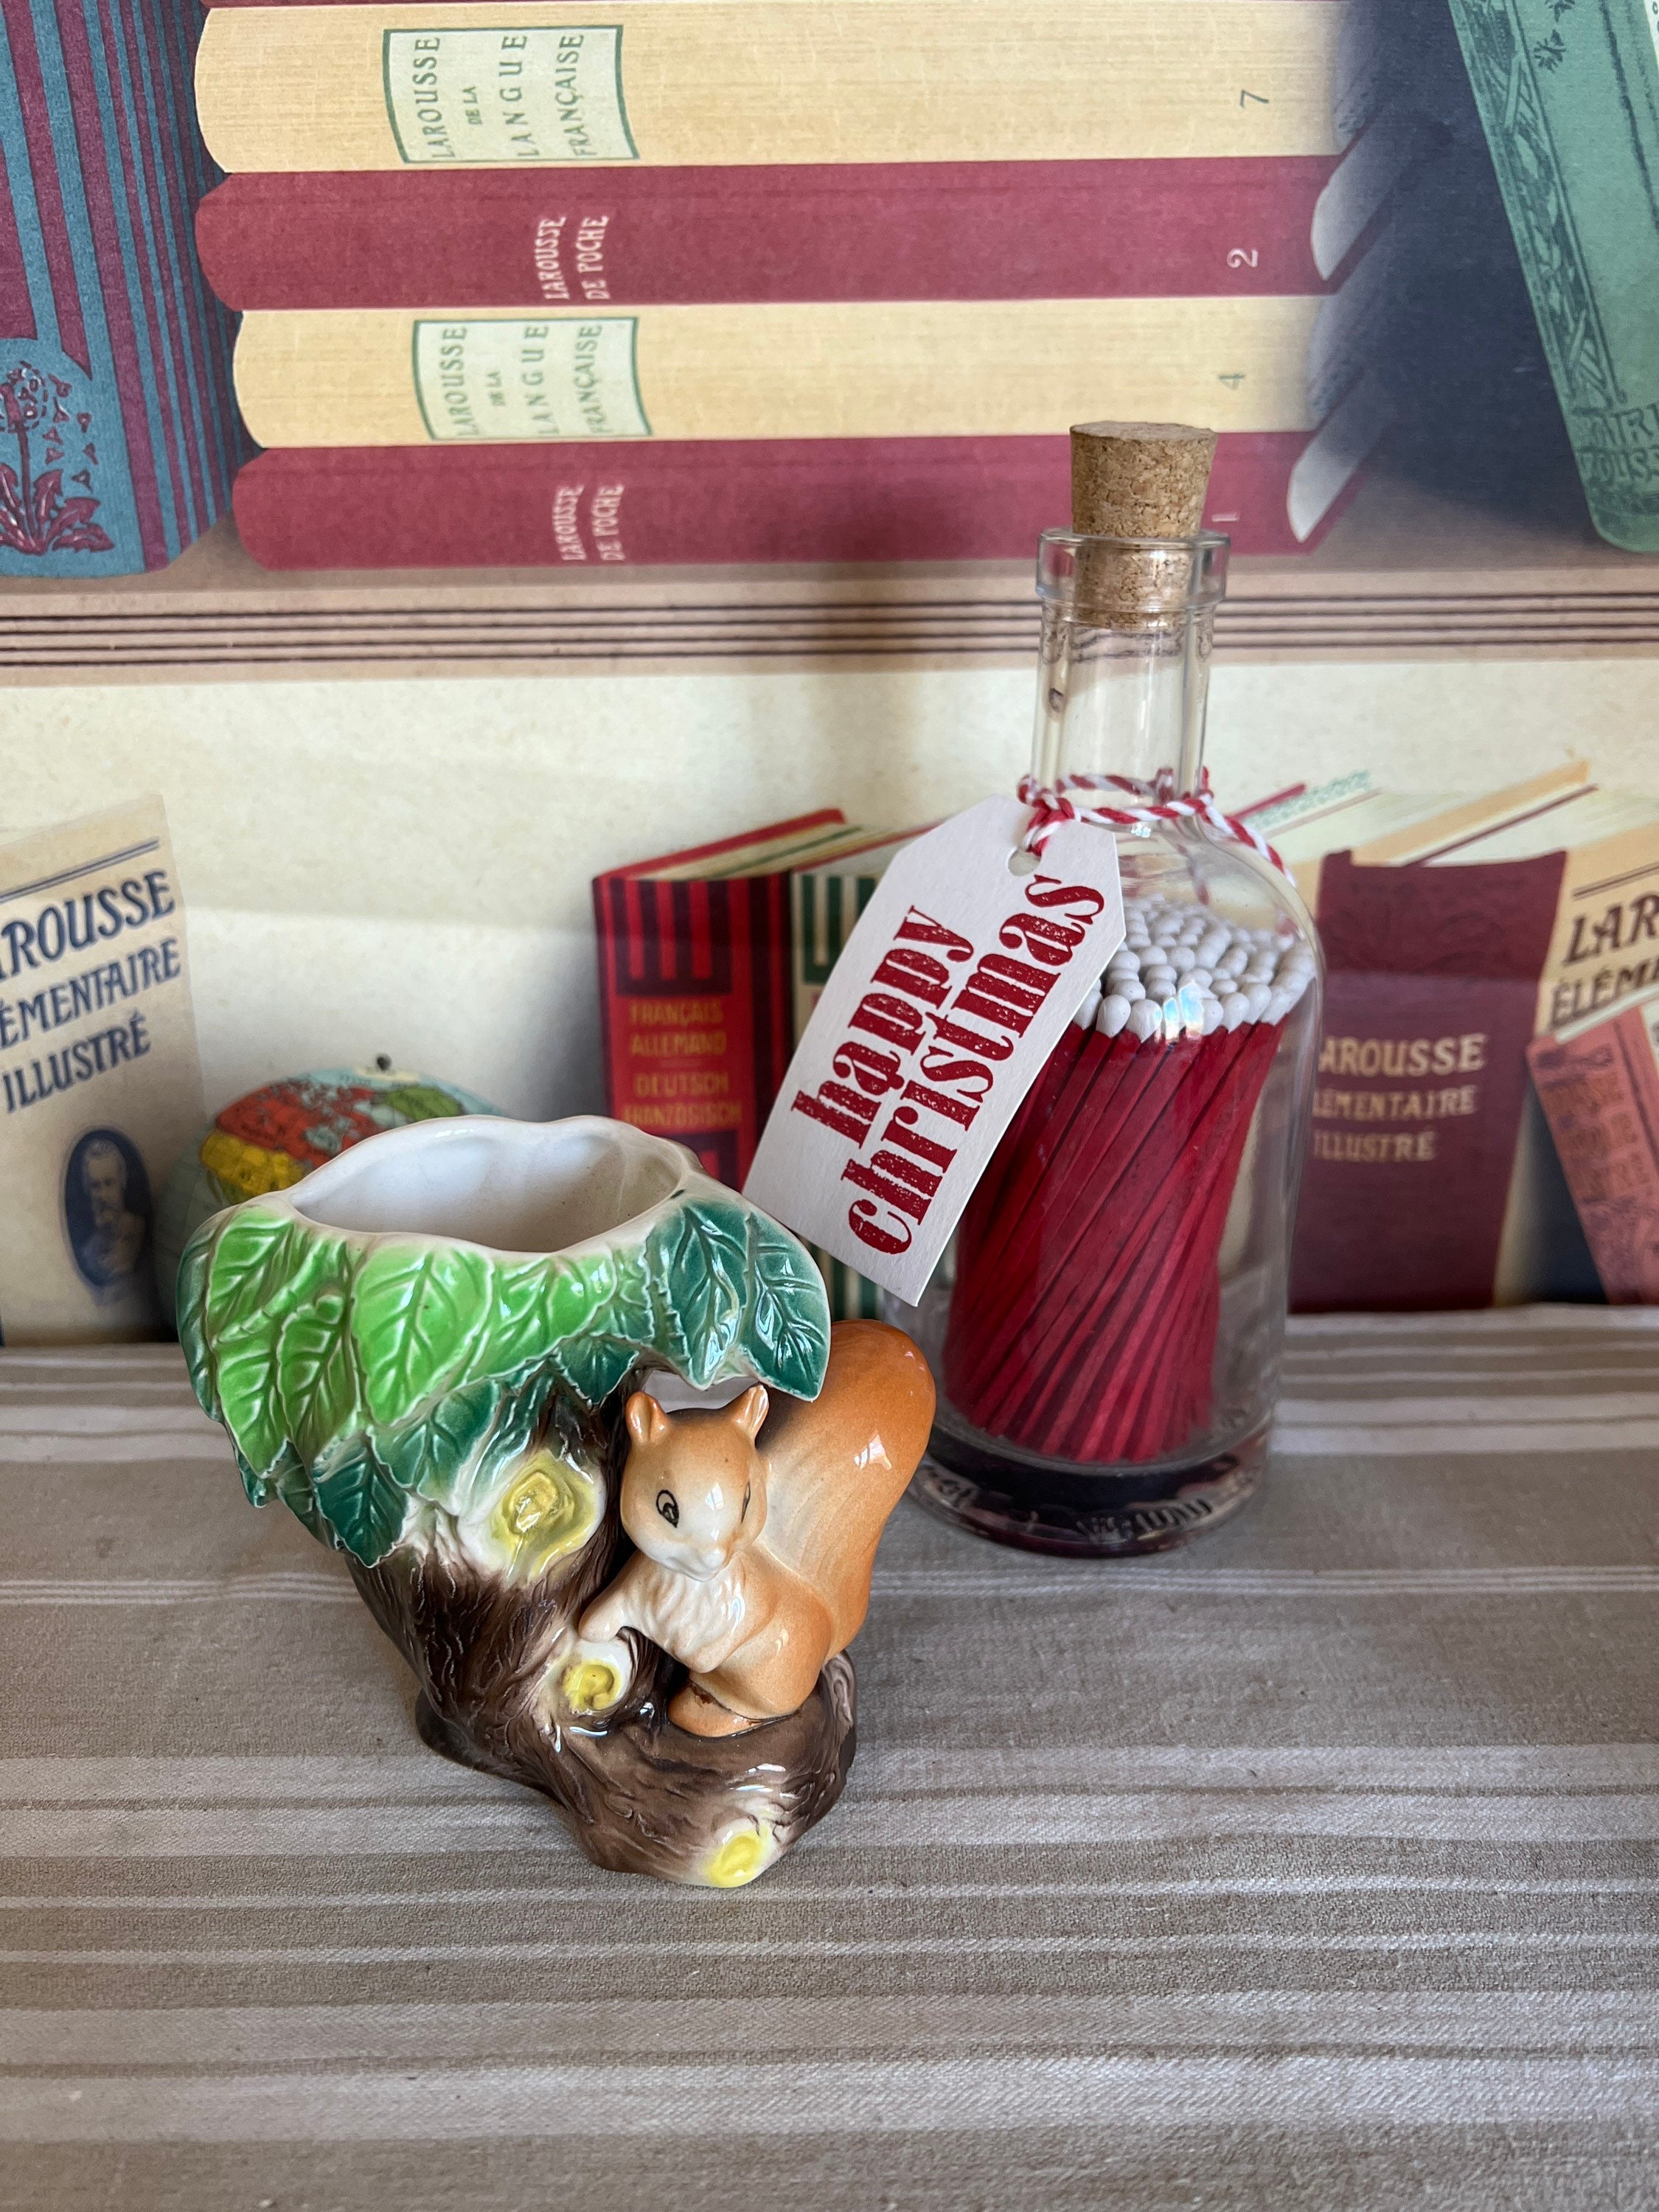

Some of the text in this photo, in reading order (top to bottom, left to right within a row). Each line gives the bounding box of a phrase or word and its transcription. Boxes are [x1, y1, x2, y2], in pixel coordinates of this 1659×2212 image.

[412, 37, 456, 159] LAROUSSE
[462, 86, 483, 125] DE LA
[498, 35, 540, 157] LANGUE
[554, 34, 597, 157] FRANÇAISE
[1239, 88, 1270, 108] 7
[534, 215, 570, 300] LAROUSSE
[575, 215, 611, 300] DE POCHE
[1226, 248, 1259, 268] 2
[440, 325, 480, 437] LAROUSSE
[484, 371, 503, 389] LA
[521, 324, 560, 435] LANGUE
[571, 324, 613, 435] FRANÇAISE
[1219, 373, 1245, 391] 4
[0, 871, 175, 982] ROUSSE
[2, 1008, 152, 1113] ILLUSTRÉ
[790, 905, 974, 1148] happy
[840, 874, 1105, 1254] christmas
[634, 1072, 729, 1098] DEUTSCH
